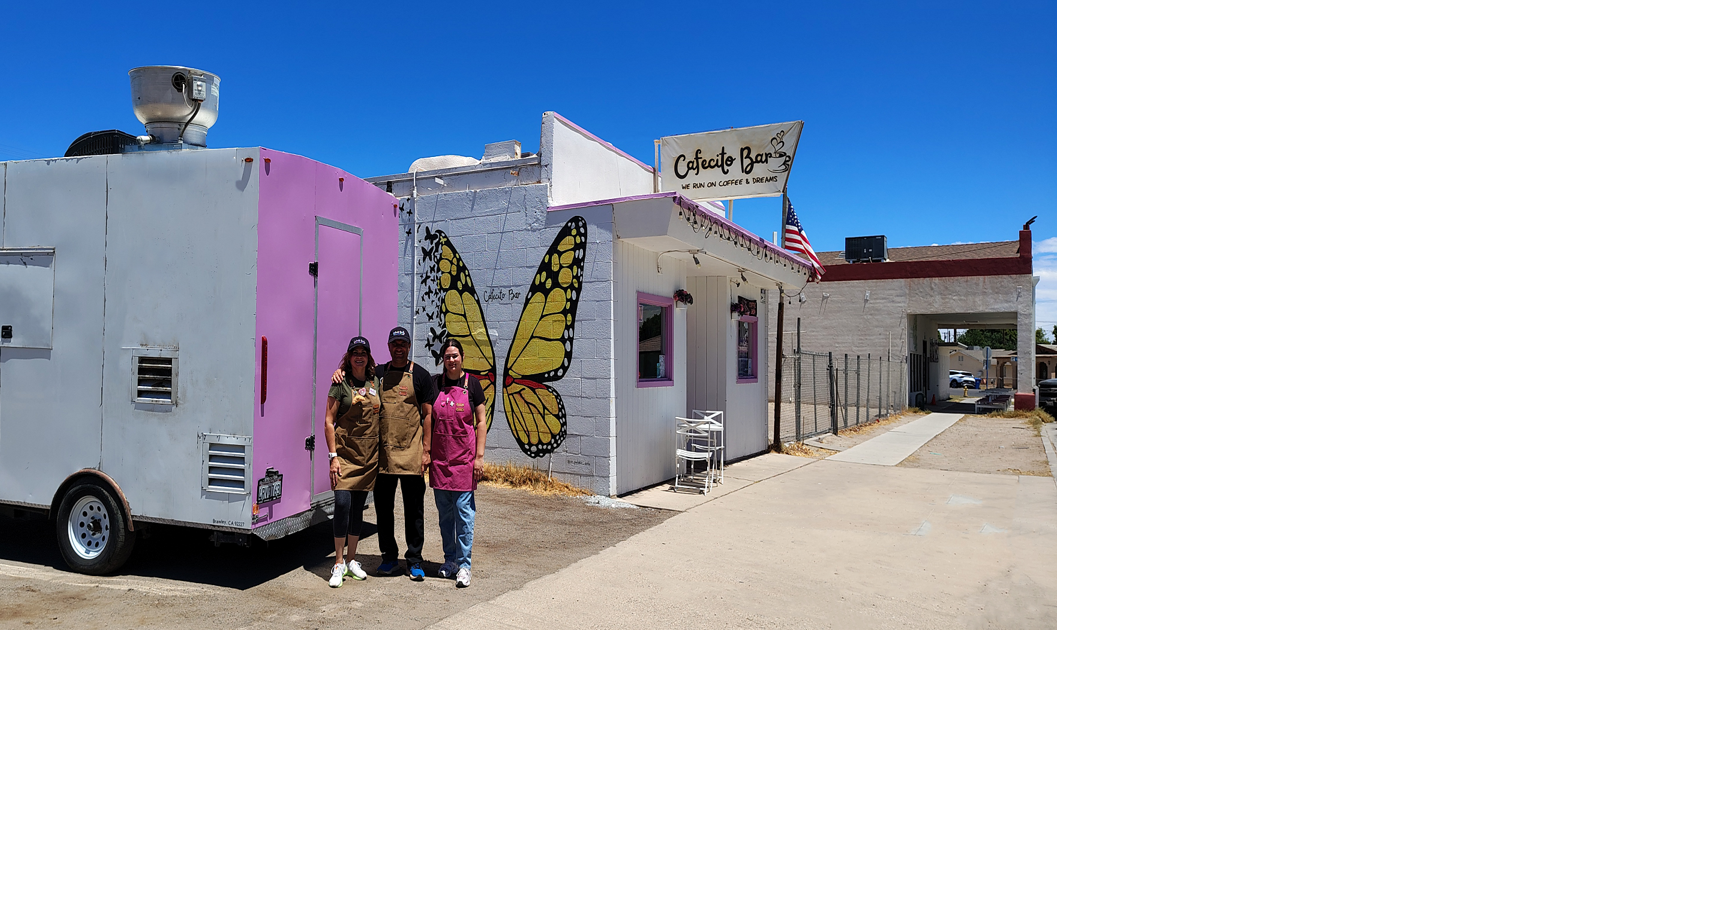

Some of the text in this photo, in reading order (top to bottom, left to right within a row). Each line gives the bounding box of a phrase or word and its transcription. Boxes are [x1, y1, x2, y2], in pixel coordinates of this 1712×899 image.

[674, 146, 772, 179] Cafecito Bar
[693, 181, 705, 189] RUN
[707, 180, 717, 188] ON
[719, 178, 743, 187] COFFEE
[746, 177, 750, 185] &
[753, 175, 778, 184] DREAMS
[509, 289, 521, 301] Bar
